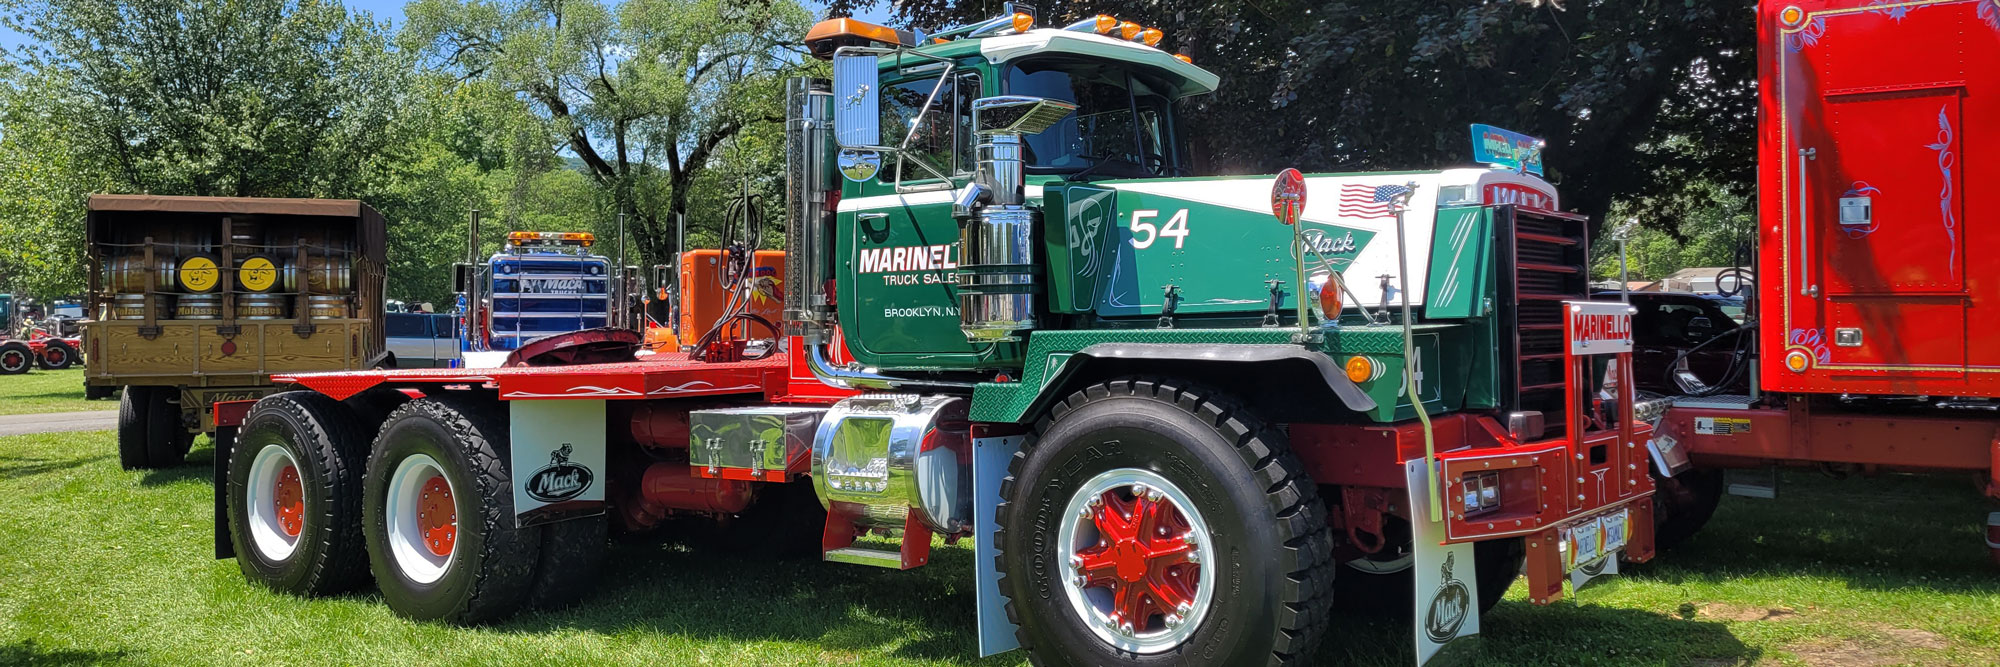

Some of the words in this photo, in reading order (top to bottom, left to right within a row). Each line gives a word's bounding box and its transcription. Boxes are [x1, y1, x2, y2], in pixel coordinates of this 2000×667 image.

[1128, 208, 1190, 250] 54
[1301, 231, 1356, 255] Mack
[859, 244, 960, 274] MARINEL
[883, 274, 919, 286] TRUCK
[1573, 314, 1632, 341] MARINELLO
[536, 468, 582, 497] Mack
[1432, 588, 1463, 633] Mack
